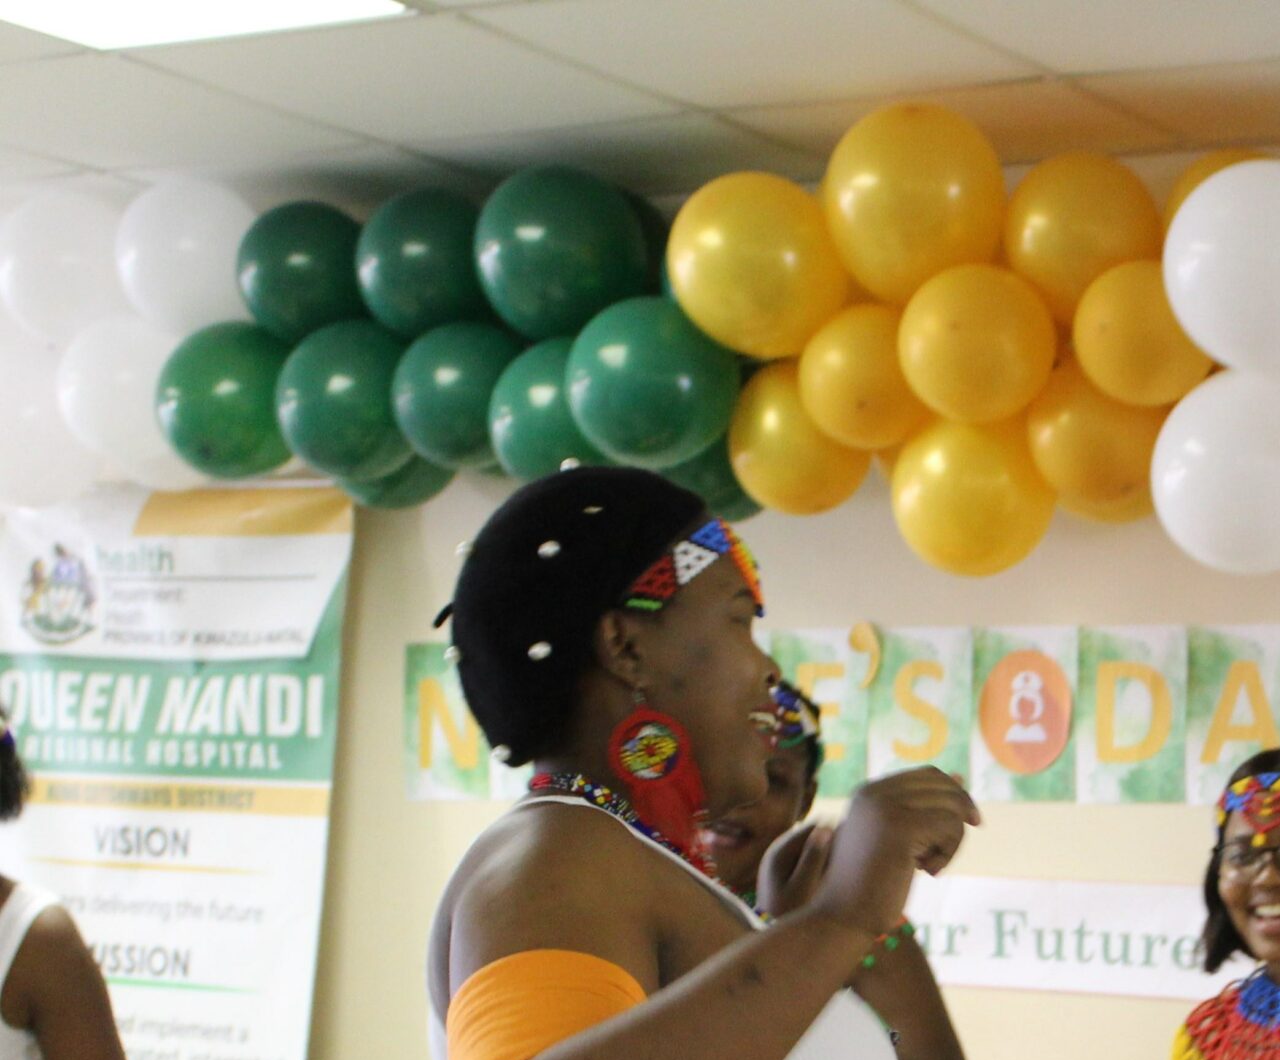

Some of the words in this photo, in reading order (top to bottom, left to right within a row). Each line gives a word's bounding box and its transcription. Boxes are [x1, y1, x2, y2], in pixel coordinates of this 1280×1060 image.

[0, 670, 149, 735] QUEEN
[155, 672, 324, 738] NANDI
[24, 734, 135, 765] REGIONAL
[146, 740, 282, 770] HOSPITAL
[95, 825, 191, 858] VISION
[94, 892, 171, 923] delivering
[176, 896, 204, 920] the
[208, 900, 264, 922] future
[989, 908, 1204, 970] Future
[139, 1017, 232, 1041] implement
